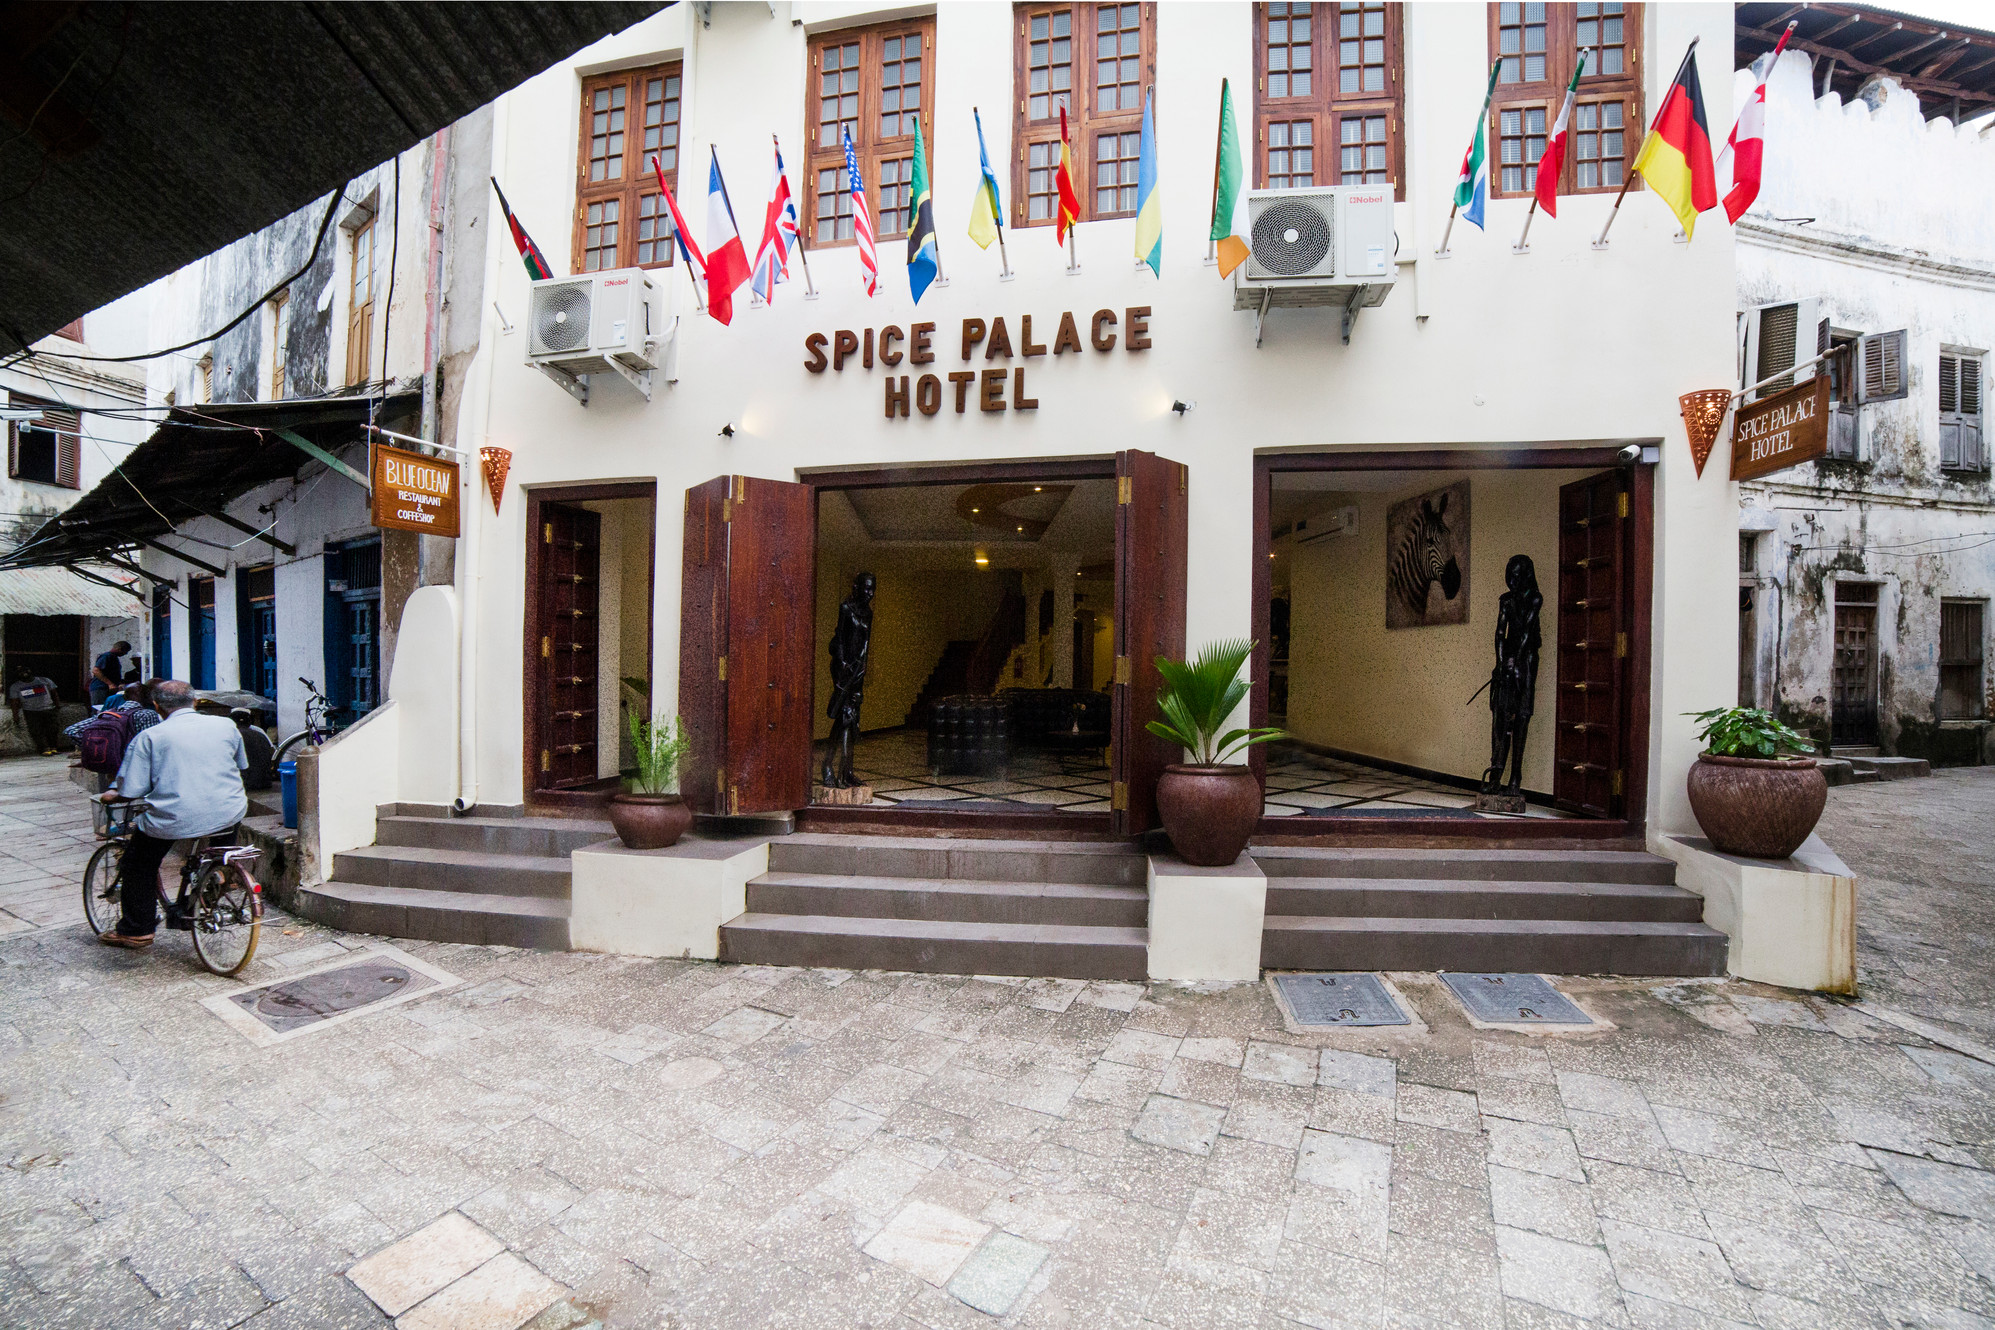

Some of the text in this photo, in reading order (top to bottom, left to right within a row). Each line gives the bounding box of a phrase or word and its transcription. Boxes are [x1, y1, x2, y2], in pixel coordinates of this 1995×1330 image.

[1356, 196, 1383, 204] Nobel
[609, 278, 629, 287] Nobel
[804, 305, 1152, 374] SPICE PALACE
[884, 366, 1040, 419] HOTEL
[1737, 413, 1769, 443] SPICE
[1750, 430, 1794, 462] HOTEL
[386, 459, 450, 495] BLUE OCEAN
[398, 490, 442, 507] RESTAURANT
[416, 503, 424, 512] &
[397, 509, 436, 524] COFFESHOP
